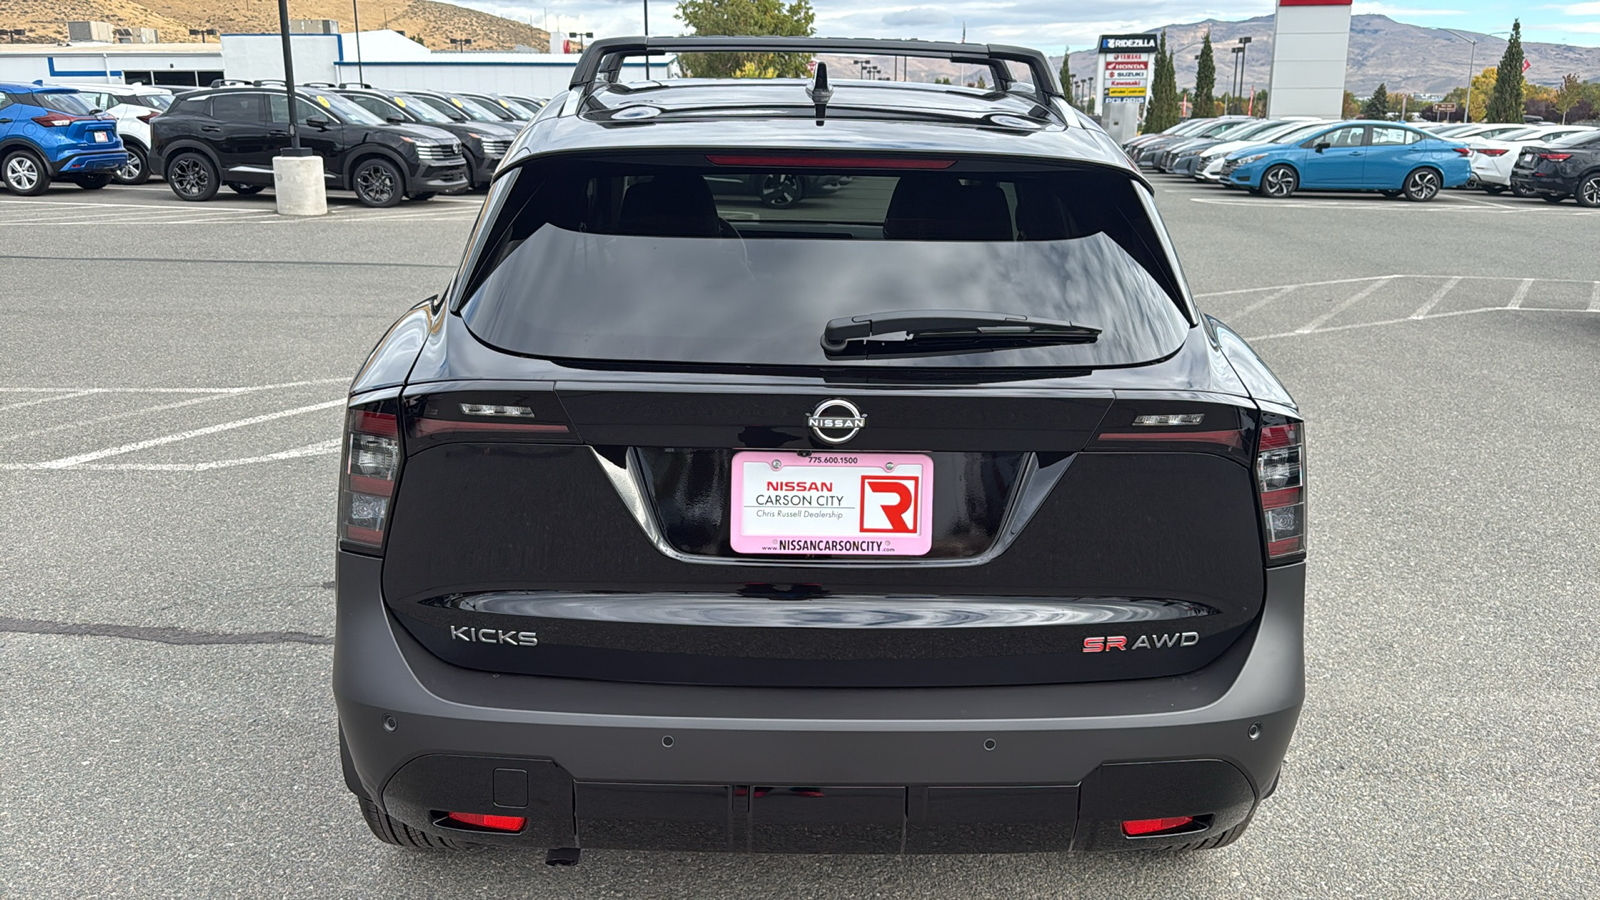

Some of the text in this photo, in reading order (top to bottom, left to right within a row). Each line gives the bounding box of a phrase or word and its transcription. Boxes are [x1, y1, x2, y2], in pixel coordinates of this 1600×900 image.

[1115, 39, 1156, 48] RIDEZILLA
[809, 419, 864, 427] NISSAN
[808, 456, 858, 464] 775.600.1500
[766, 481, 833, 492] NISSAN
[755, 494, 844, 507] CARSON CITY
[756, 509, 843, 520] Chris Russell Dealership
[450, 625, 538, 647] KICKS
[1082, 631, 1200, 653] SR AWD
